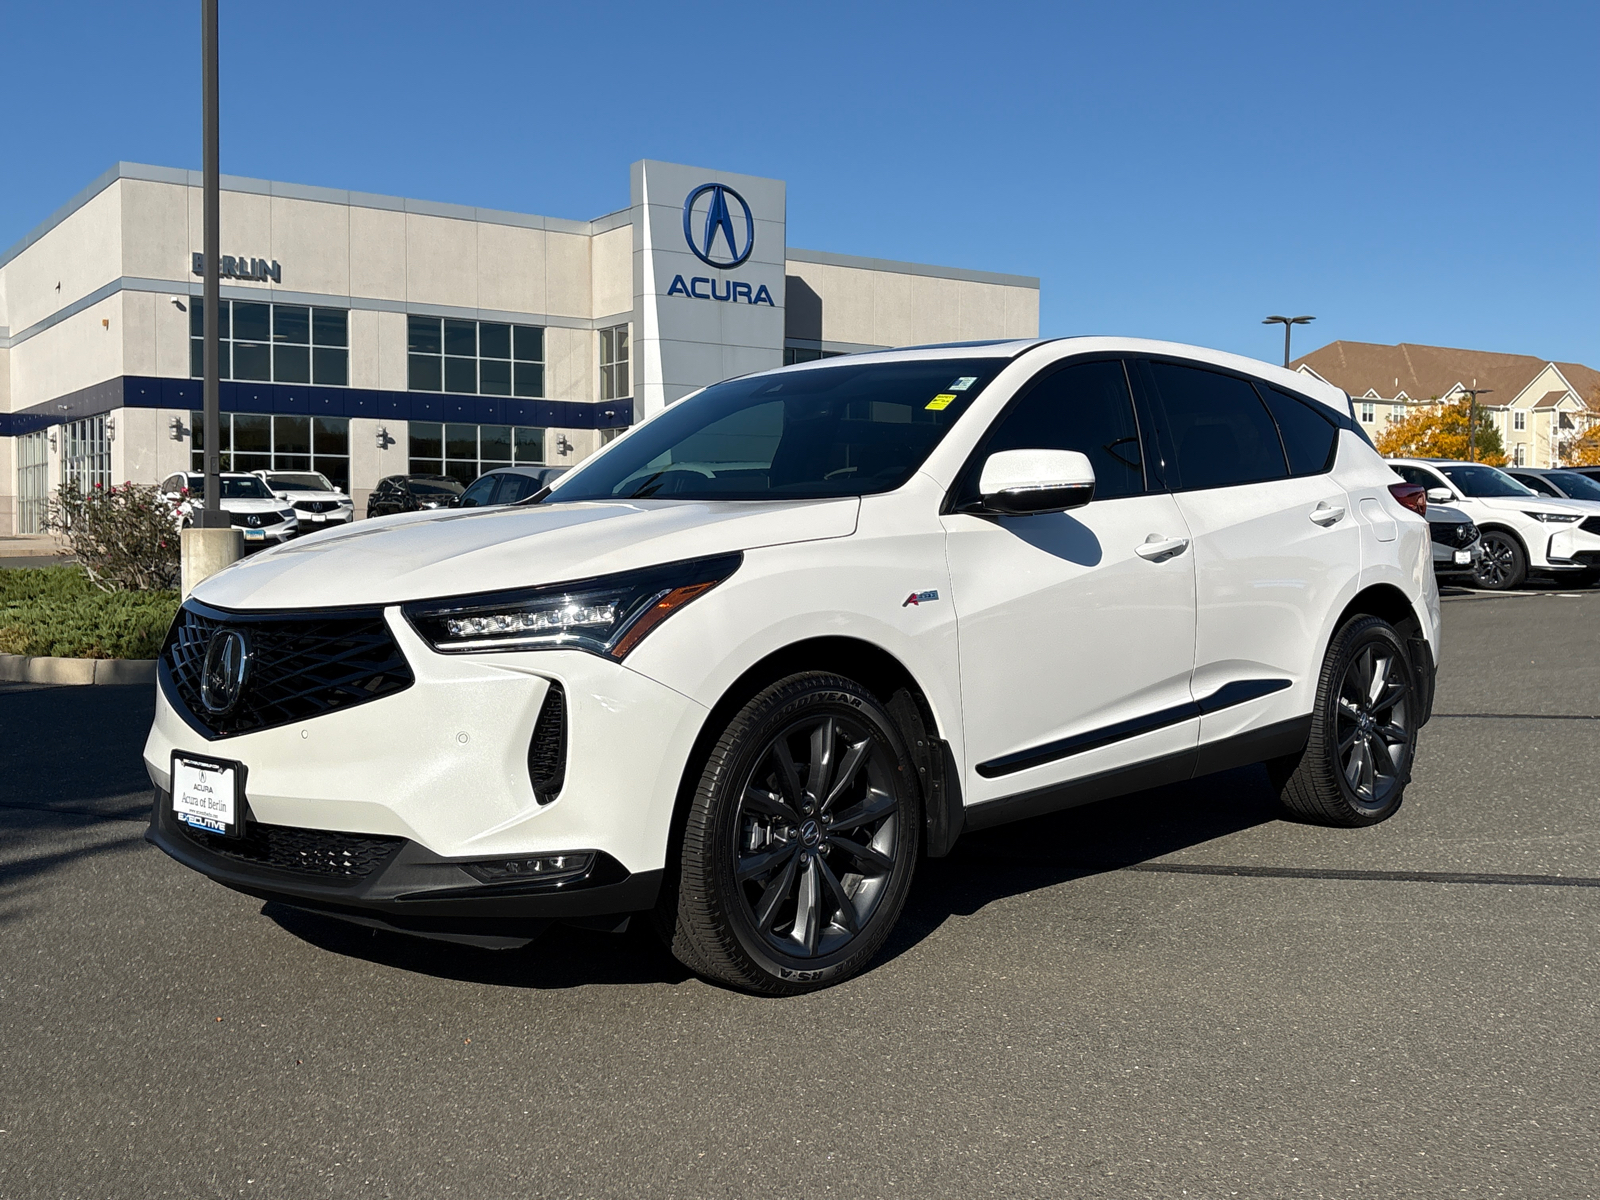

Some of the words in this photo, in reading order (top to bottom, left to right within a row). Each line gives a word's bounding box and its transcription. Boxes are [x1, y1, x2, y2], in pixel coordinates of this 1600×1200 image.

[192, 252, 281, 284] BRLIN
[667, 275, 775, 307] ACURA
[193, 783, 214, 794] ACURA
[181, 792, 199, 806] Acura
[199, 797, 207, 808] of
[207, 797, 227, 813] Berlin
[177, 812, 226, 832] EXECUTIVE
